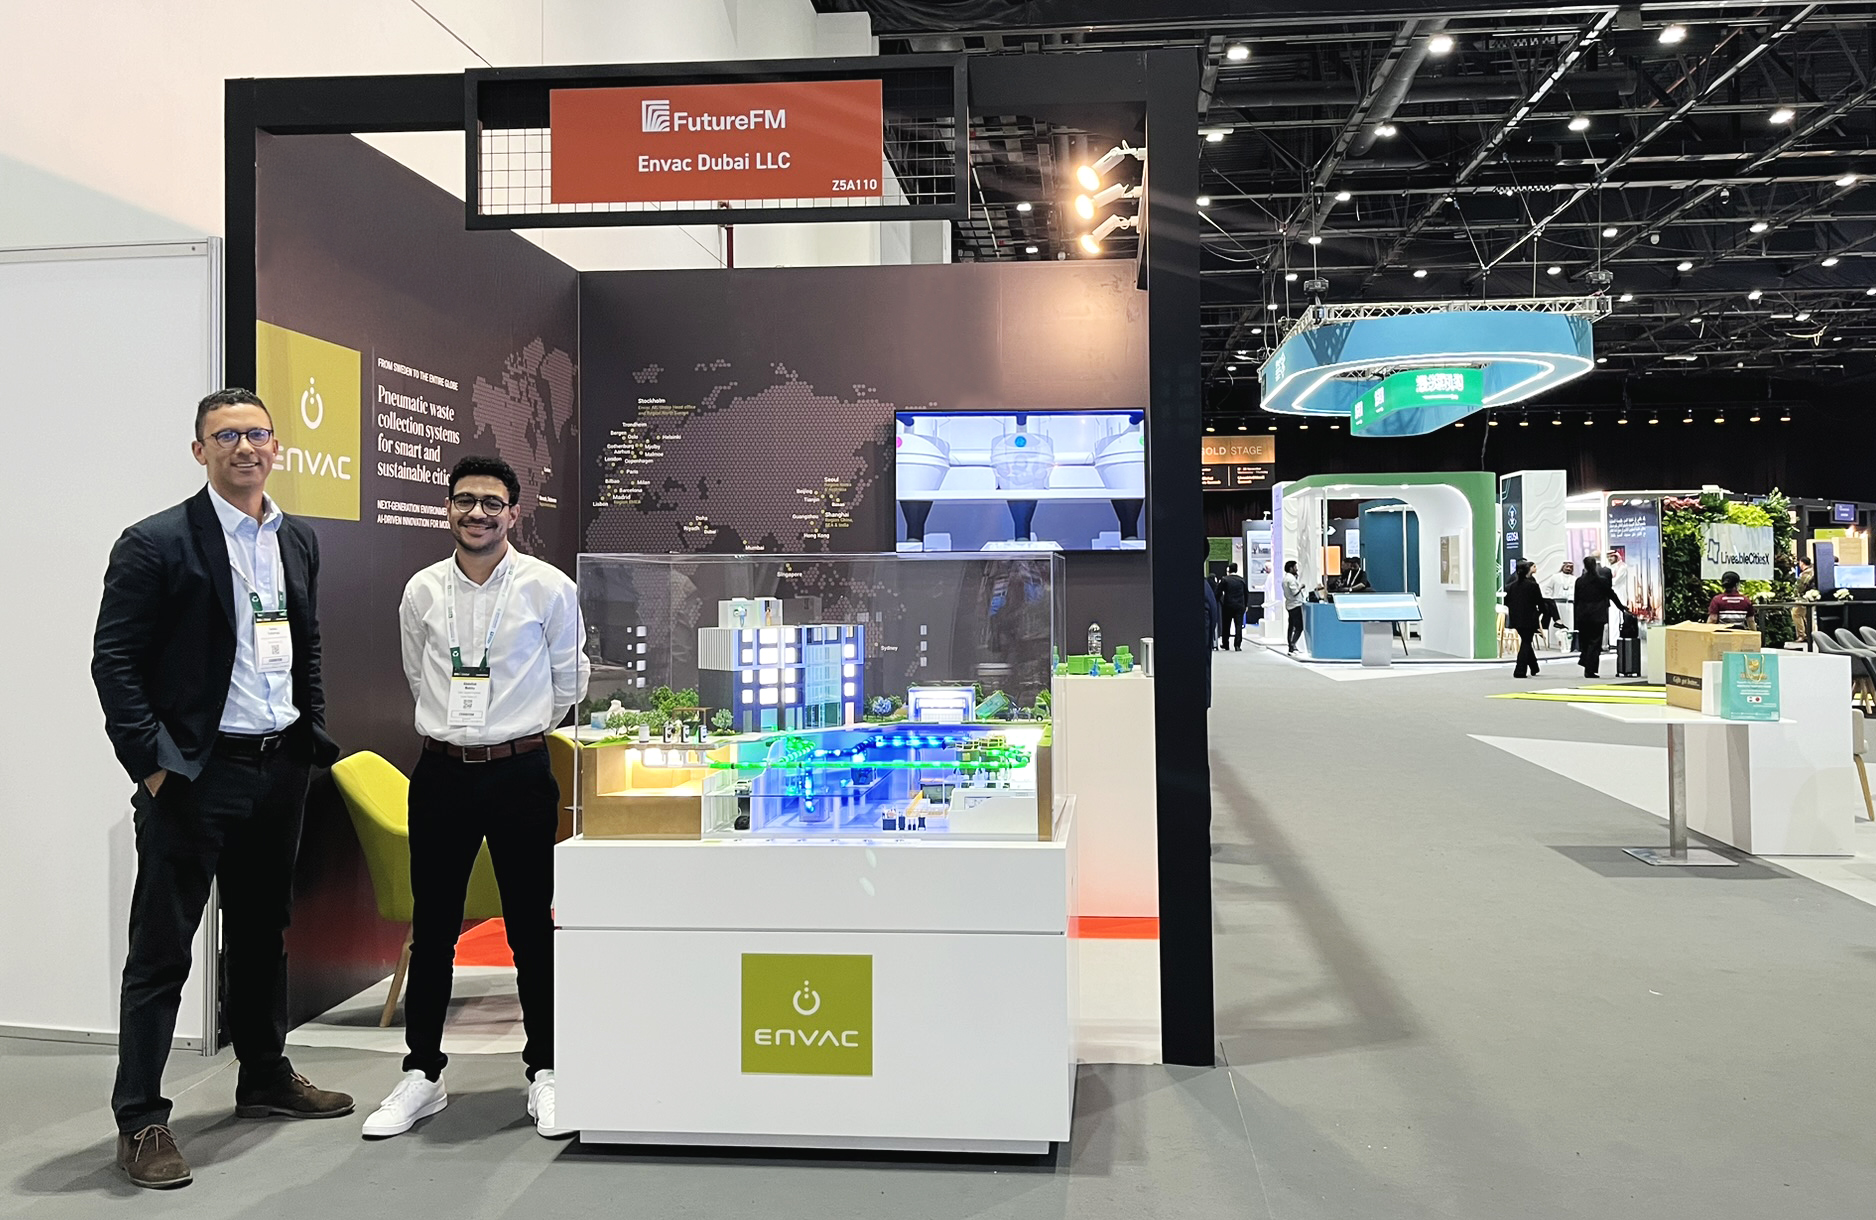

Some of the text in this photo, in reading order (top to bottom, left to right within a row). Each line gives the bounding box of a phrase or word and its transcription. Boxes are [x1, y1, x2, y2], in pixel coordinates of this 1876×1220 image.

[674, 109, 785, 131] FutureFM
[639, 152, 790, 172] Envac Dubai LLC
[832, 179, 877, 190] Z5A110
[378, 358, 458, 391] FROM SWEDEN TO THE ENTIRE GLOBE
[378, 385, 454, 421] Pneumatic waste
[378, 411, 459, 444] collection systems
[378, 433, 440, 462] for smart and
[1230, 445, 1263, 456] STAGE
[272, 446, 350, 479] ENVAC
[378, 462, 431, 483] sustainable
[377, 500, 420, 512] NEXT-GENERATION
[403, 517, 429, 527] INNOVATION
[1720, 551, 1770, 566] LiveableCitiesX
[755, 1029, 858, 1046] ENVAC
